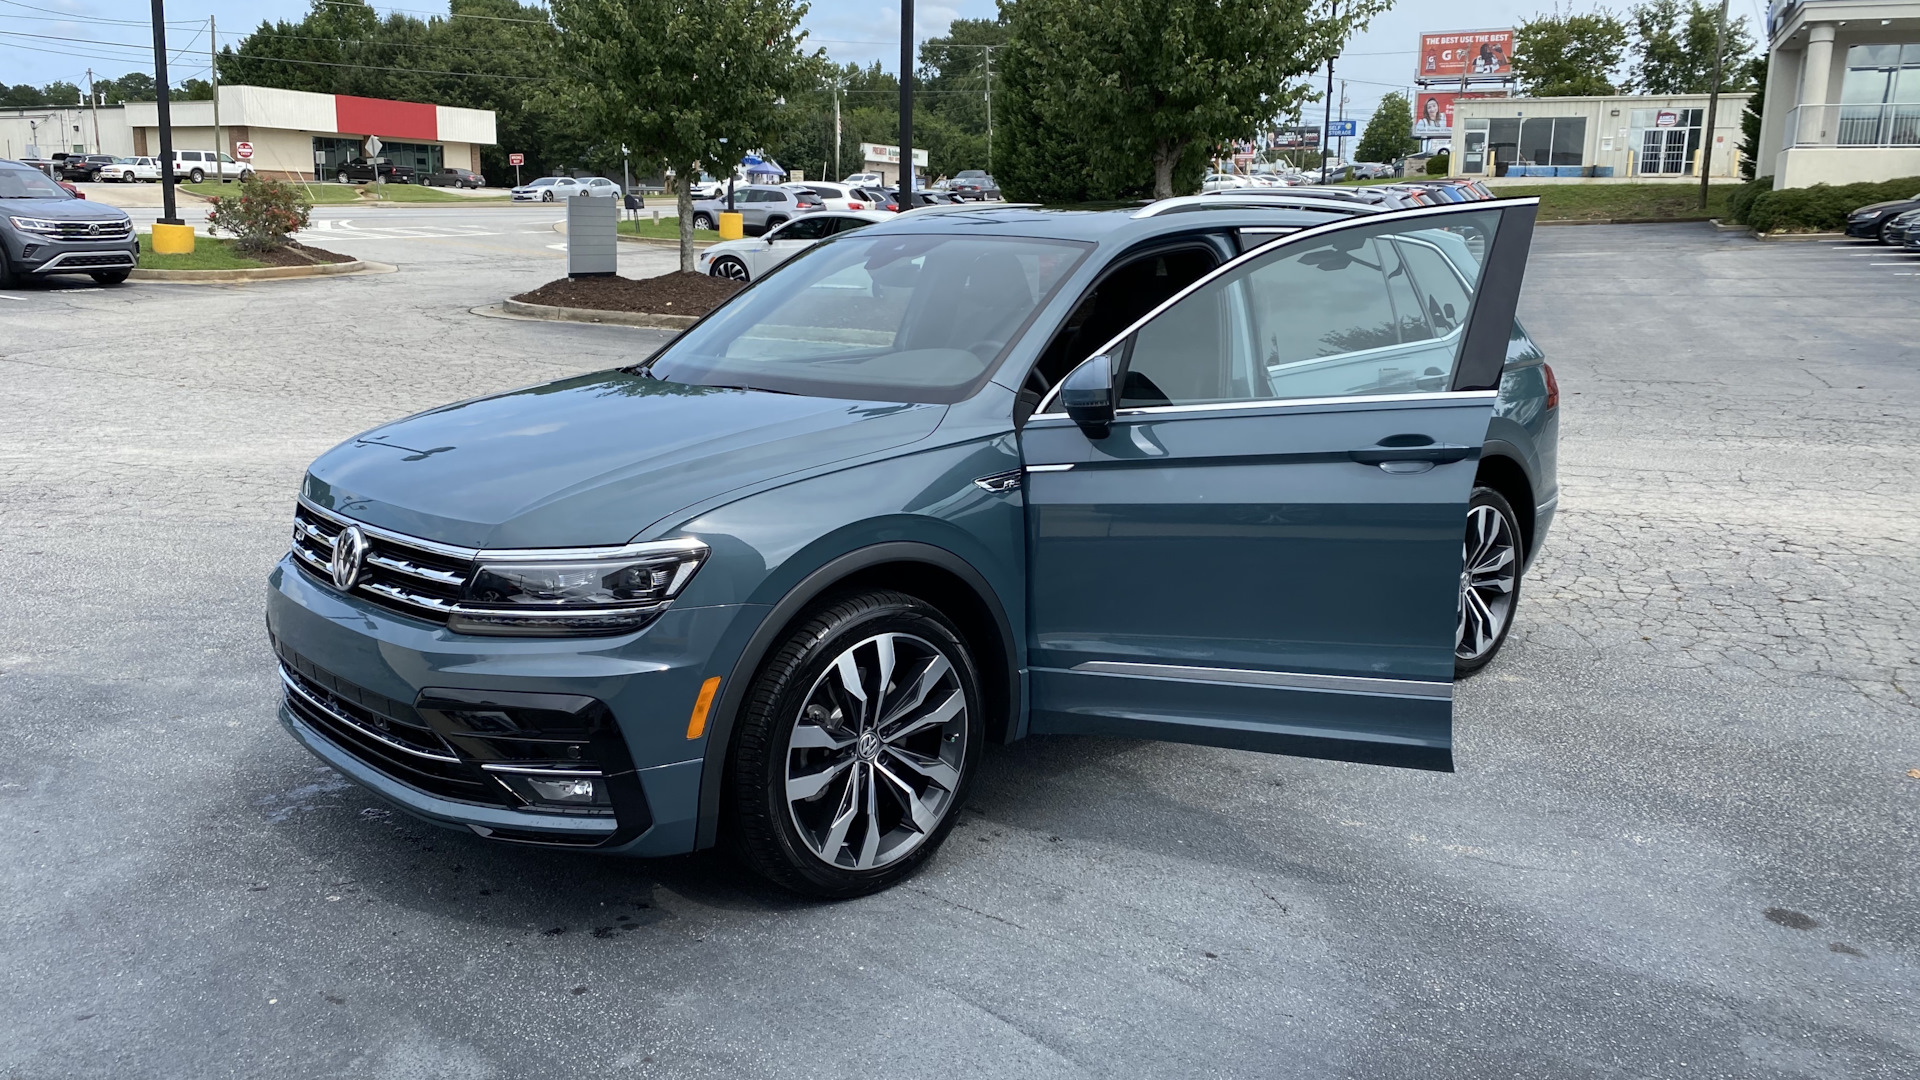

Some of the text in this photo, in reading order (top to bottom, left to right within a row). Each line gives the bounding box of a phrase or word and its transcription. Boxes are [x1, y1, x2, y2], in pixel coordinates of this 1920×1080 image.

[1441, 36, 1459, 44] BEST
[1460, 35, 1474, 43] USE
[1475, 34, 1489, 43] THE
[1490, 33, 1509, 42] BEST
[1442, 49, 1452, 61] G
